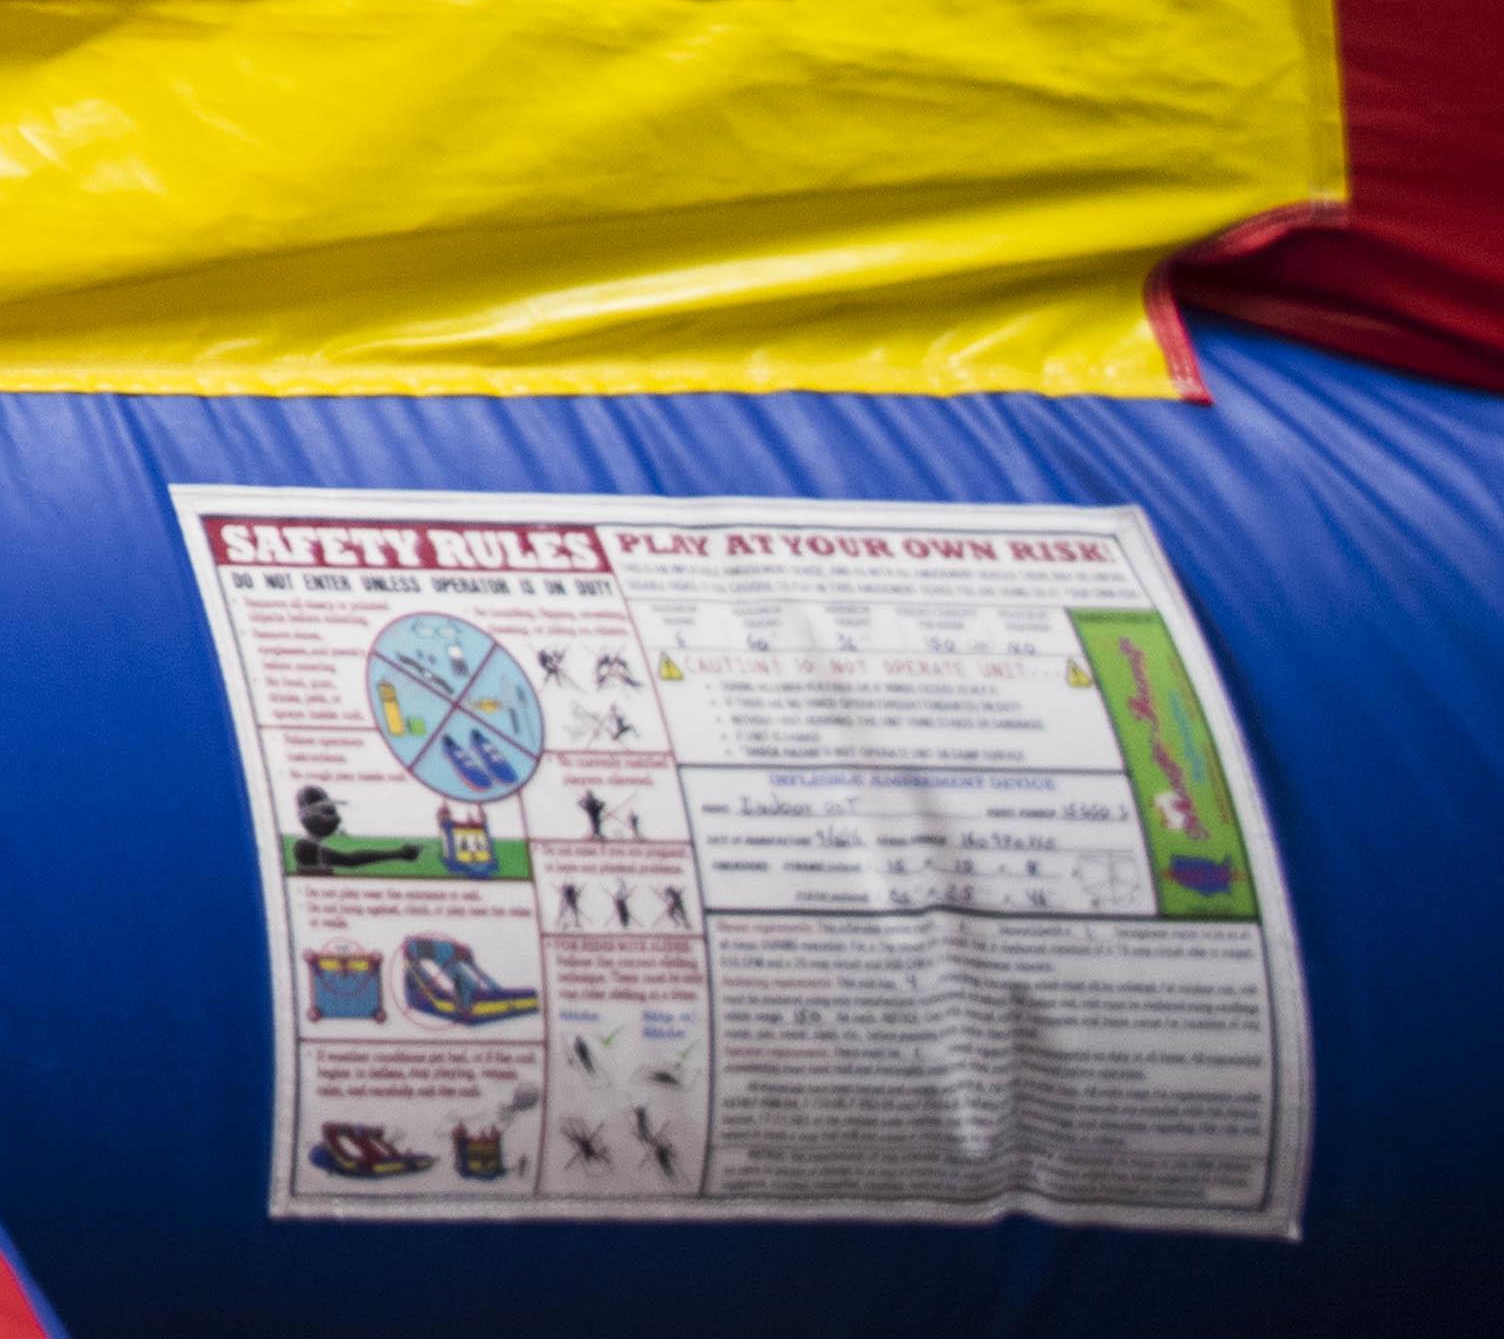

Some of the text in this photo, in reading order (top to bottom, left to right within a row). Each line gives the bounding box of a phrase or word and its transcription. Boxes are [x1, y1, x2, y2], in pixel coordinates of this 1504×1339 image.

[220, 524, 599, 570] SAFETY RULES
[616, 534, 709, 557] PLAY
[725, 534, 774, 555] AT
[777, 535, 894, 558] YOUR
[902, 538, 998, 561] OWN
[232, 572, 254, 589] DO
[264, 573, 293, 590] NOT
[303, 574, 350, 592] ENTER
[360, 575, 421, 593] UNLESS
[431, 576, 510, 595] OPERATOR
[519, 577, 536, 595] IS
[545, 577, 566, 596] ON
[575, 577, 614, 597] DUTY
